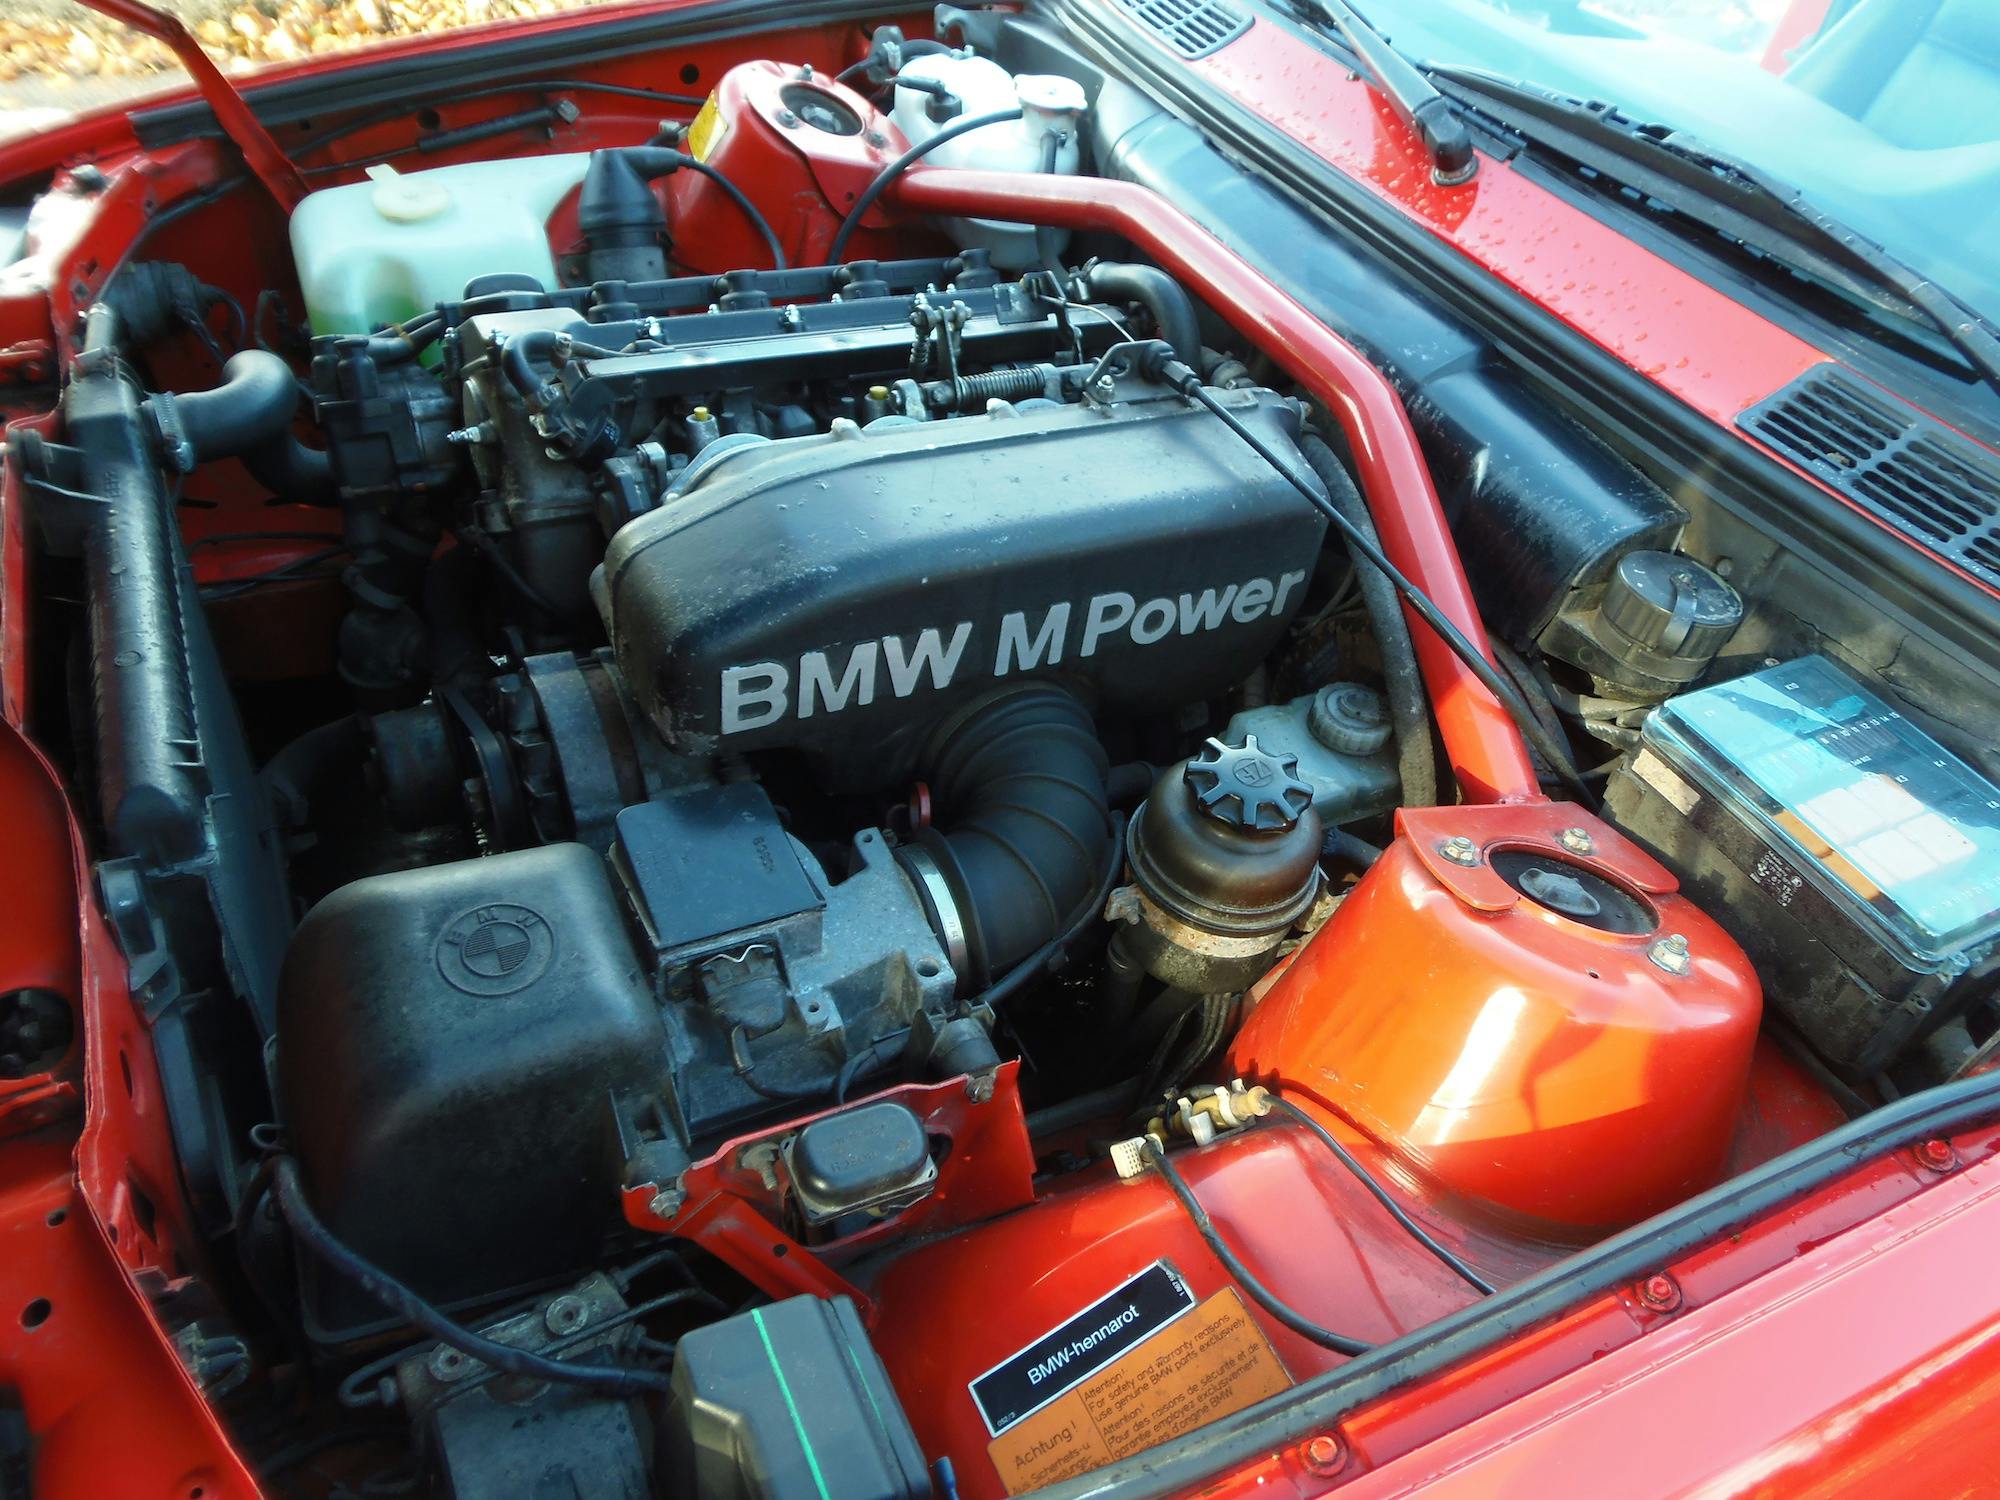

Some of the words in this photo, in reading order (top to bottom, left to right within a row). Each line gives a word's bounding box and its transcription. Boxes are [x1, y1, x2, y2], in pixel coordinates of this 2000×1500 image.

[721, 622, 972, 735] BMW
[994, 602, 1070, 678] M
[1080, 570, 1304, 658] Power
[1860, 722, 1871, 730] 12
[1879, 715, 1890, 723] 14
[1889, 711, 1901, 719] 15
[1027, 1304, 1140, 1386] BMW-hennarot
[1088, 1398, 1105, 1412] For
[1108, 1379, 1136, 1401] safety
[1137, 1364, 1154, 1381] and
[1155, 1340, 1193, 1368] warranty
[1194, 1314, 1231, 1342] reasons
[1094, 1407, 1113, 1422] use
[1114, 1382, 1149, 1412] genuine
[1149, 1364, 1173, 1385] BMW
[1174, 1350, 1198, 1371] parts
[1199, 1317, 1246, 1353] exclusively
[1108, 1430, 1130, 1448] Pour
[1132, 1417, 1151, 1433] des
[1151, 1393, 1186, 1420] raisons
[1187, 1383, 1199, 1396] de
[1237, 1350, 1247, 1362] et
[1248, 1342, 1260, 1354] de
[1153, 1400, 1195, 1432] employez
[1196, 1355, 1258, 1403] exclusivement
[1209, 1385, 1233, 1408] BMW
[1015, 1428, 1073, 1470] Achtung
